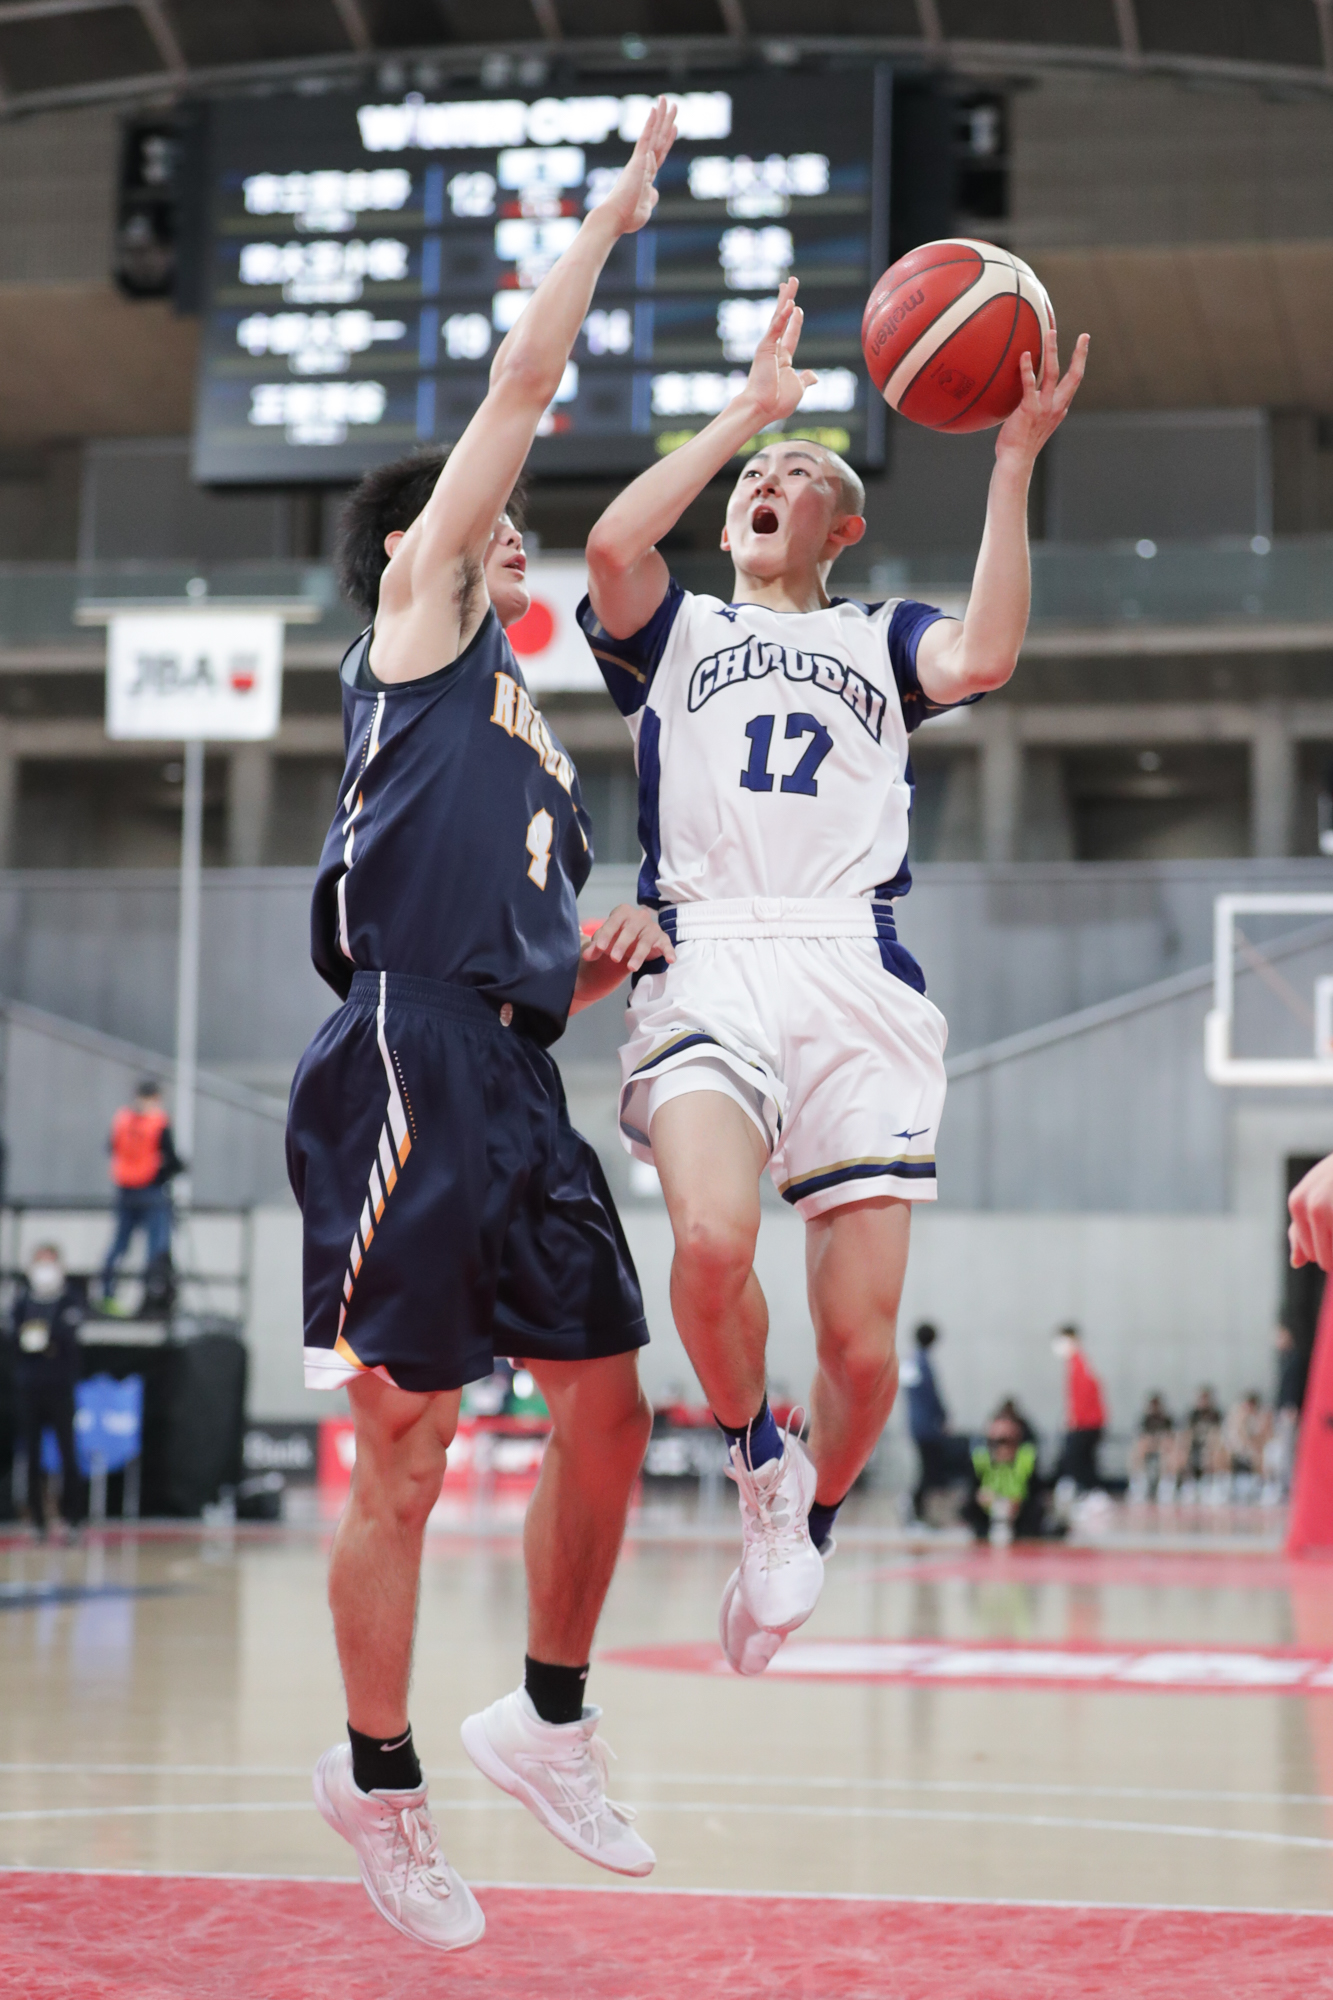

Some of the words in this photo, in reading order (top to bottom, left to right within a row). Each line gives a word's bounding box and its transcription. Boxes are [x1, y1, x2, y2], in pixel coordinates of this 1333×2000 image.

[871, 289, 926, 357] molten
[740, 712, 834, 797] 17
[525, 808, 554, 892] 4
